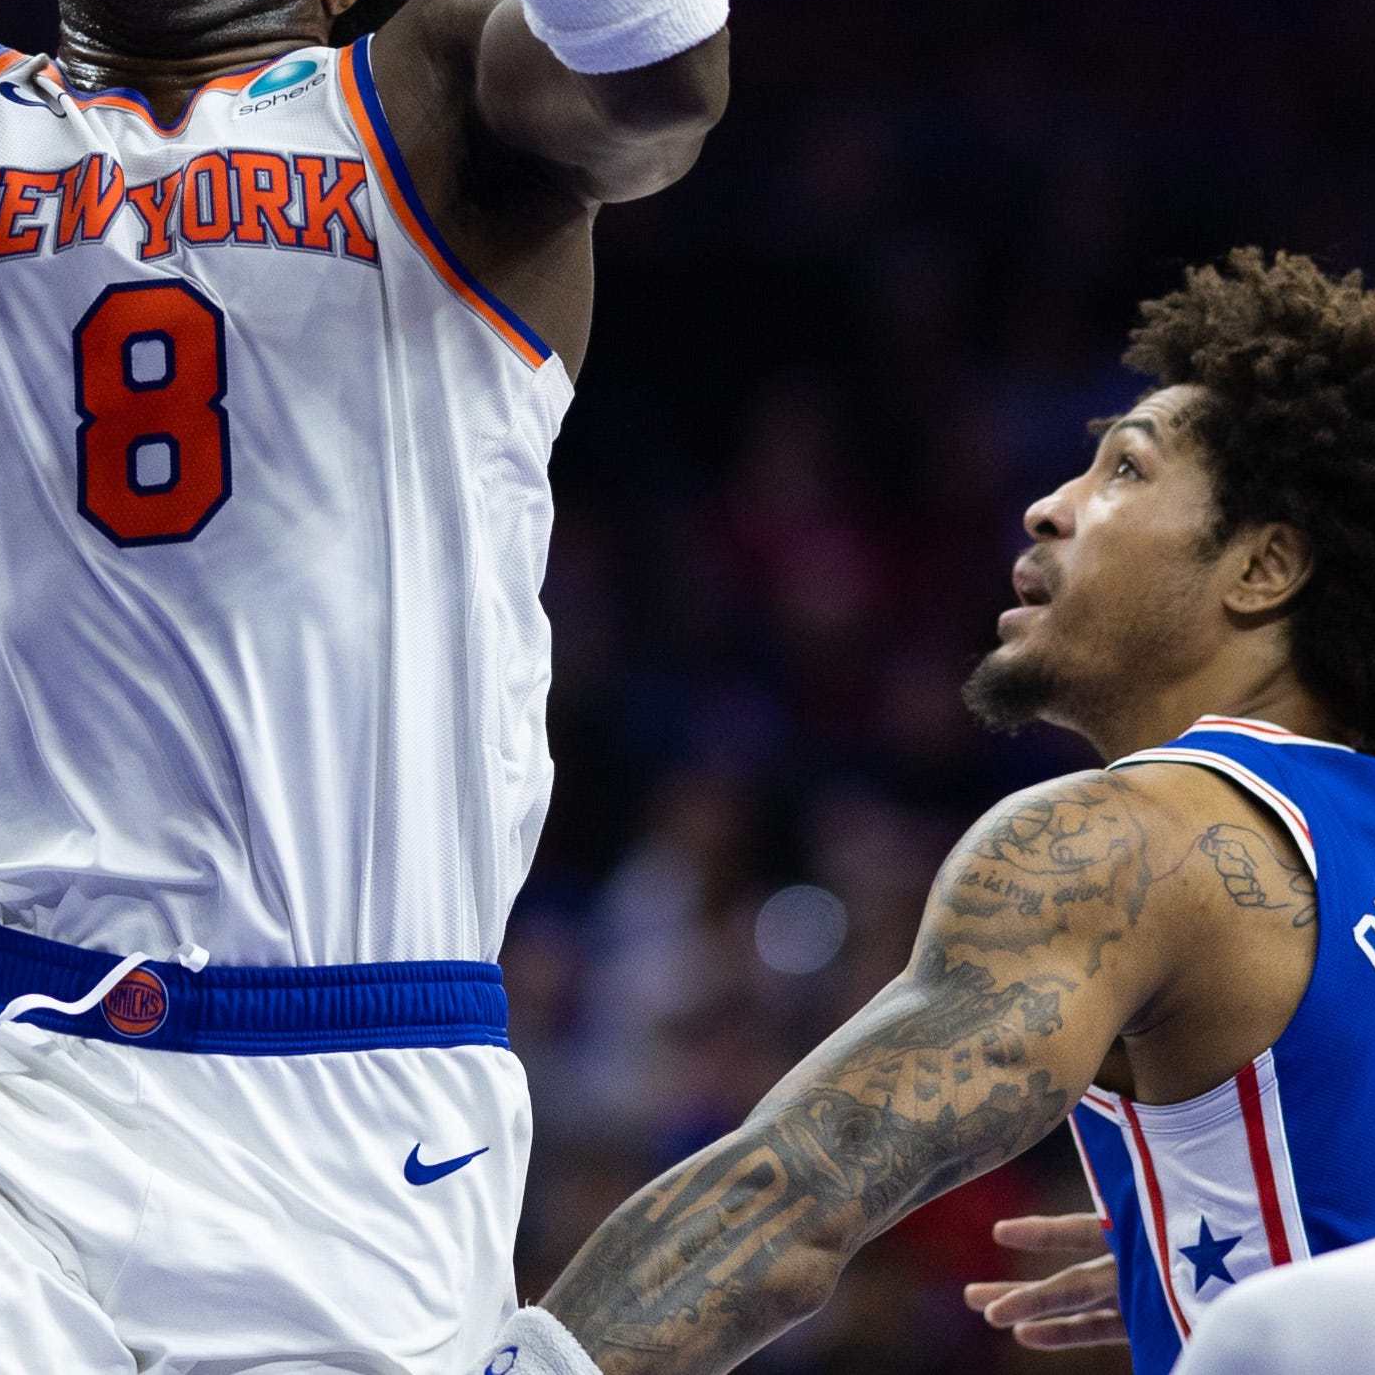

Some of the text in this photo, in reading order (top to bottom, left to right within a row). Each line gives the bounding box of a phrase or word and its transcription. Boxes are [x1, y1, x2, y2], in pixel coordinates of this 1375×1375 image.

[239, 72, 326, 116] sphere
[127, 148, 383, 270] YORK
[72, 277, 232, 549] 8
